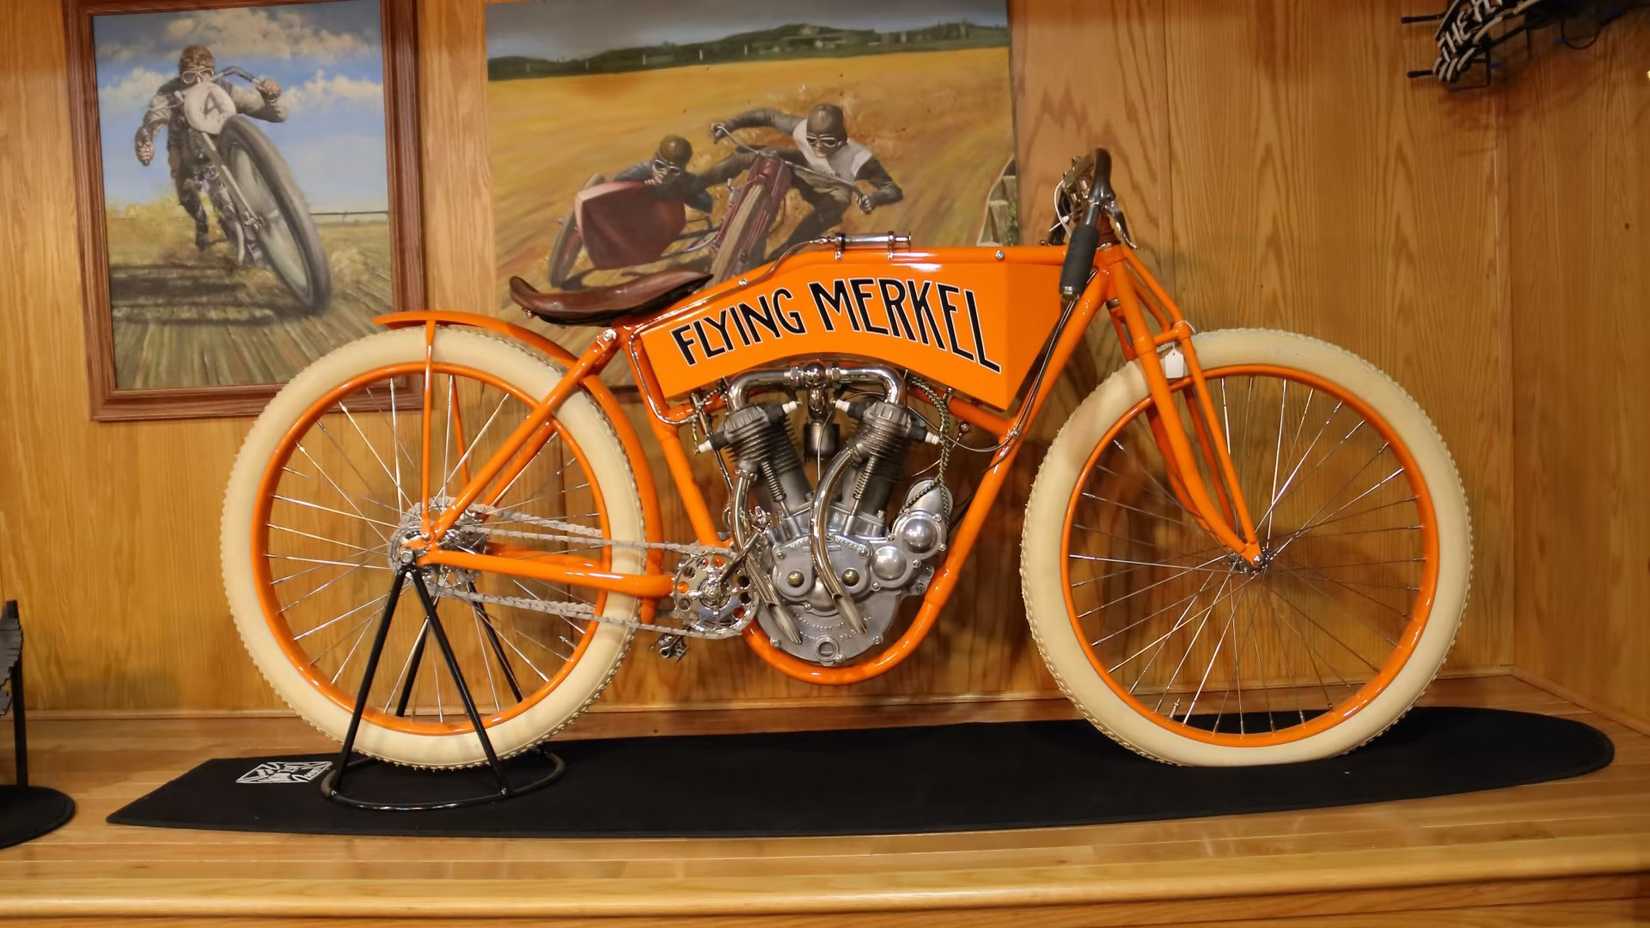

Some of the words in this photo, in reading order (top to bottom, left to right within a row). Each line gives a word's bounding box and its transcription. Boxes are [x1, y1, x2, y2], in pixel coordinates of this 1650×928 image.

[1437, 9, 1473, 62] THE
[671, 287, 806, 367] FLYING
[807, 276, 1002, 374] MERKEL
